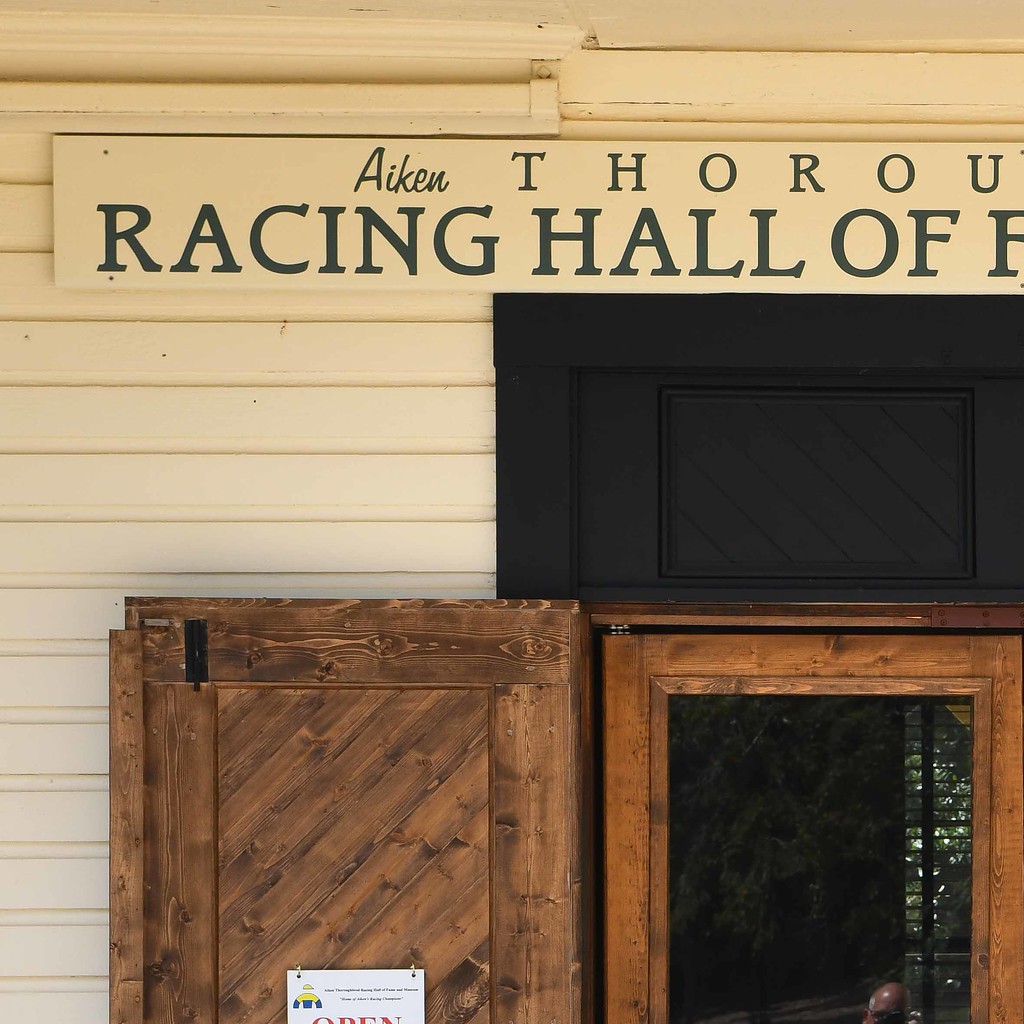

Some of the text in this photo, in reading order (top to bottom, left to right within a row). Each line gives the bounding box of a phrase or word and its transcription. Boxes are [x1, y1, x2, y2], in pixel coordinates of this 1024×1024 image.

[353, 146, 450, 195] Aiken
[96, 202, 501, 277] RACING
[530, 207, 806, 279] HALL
[830, 208, 961, 278] OF
